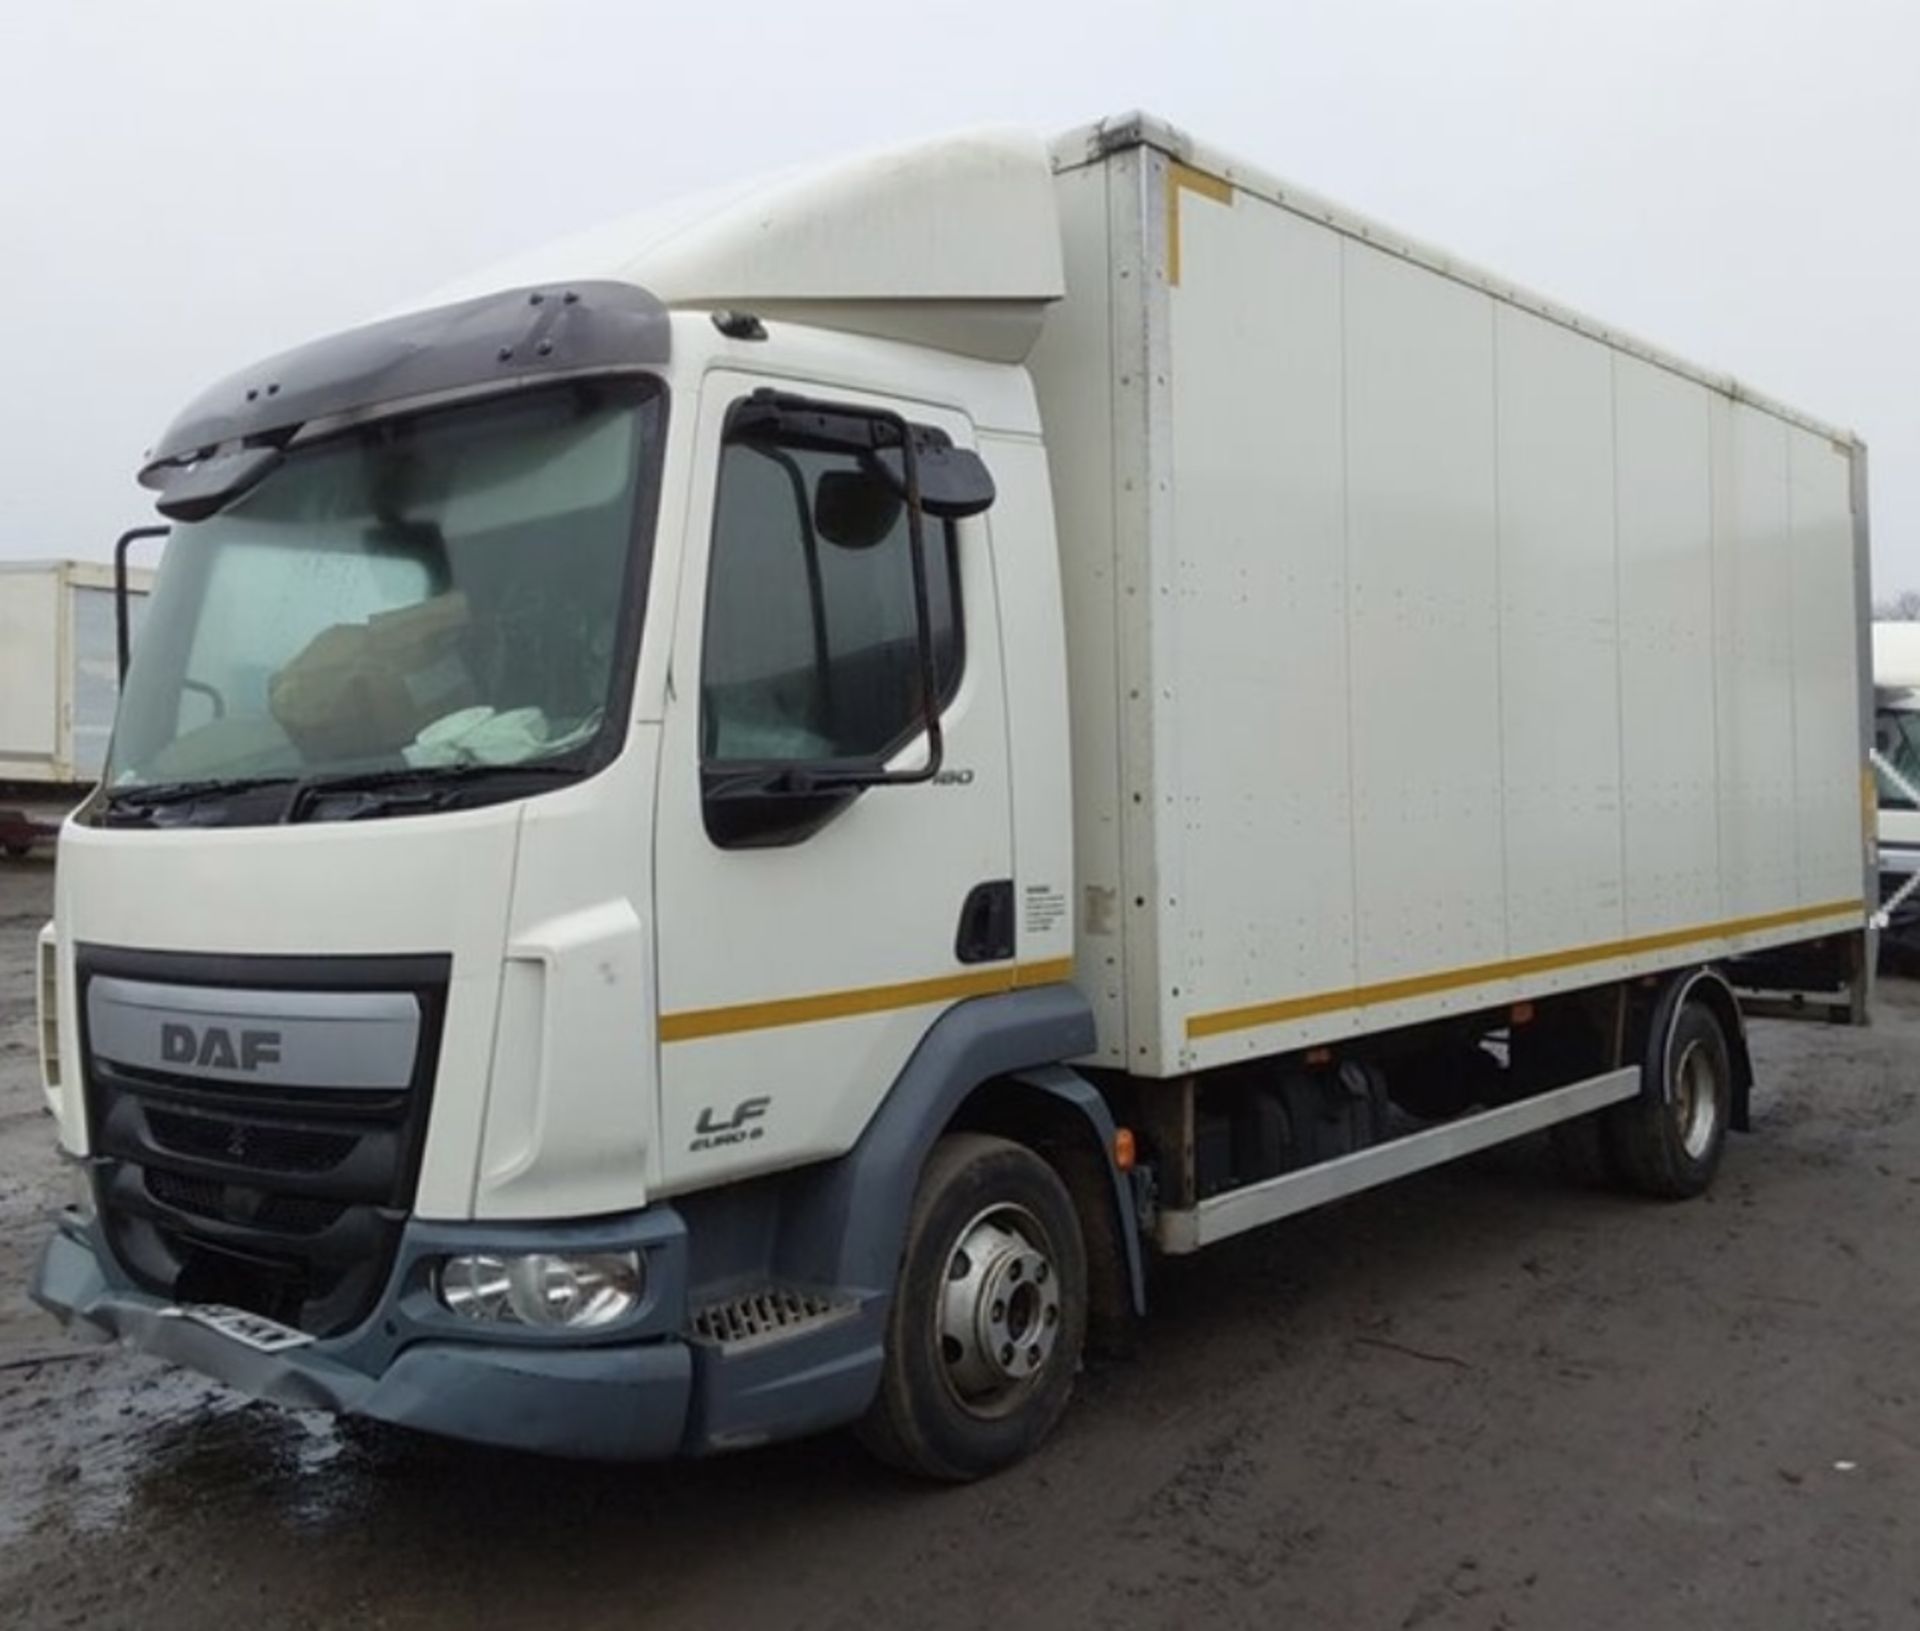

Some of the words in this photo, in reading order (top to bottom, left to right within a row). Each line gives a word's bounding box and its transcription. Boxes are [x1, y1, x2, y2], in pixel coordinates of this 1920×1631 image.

[162, 1022, 281, 1072] DAF
[696, 1096, 770, 1134] LF
[689, 1130, 747, 1152] EURO
